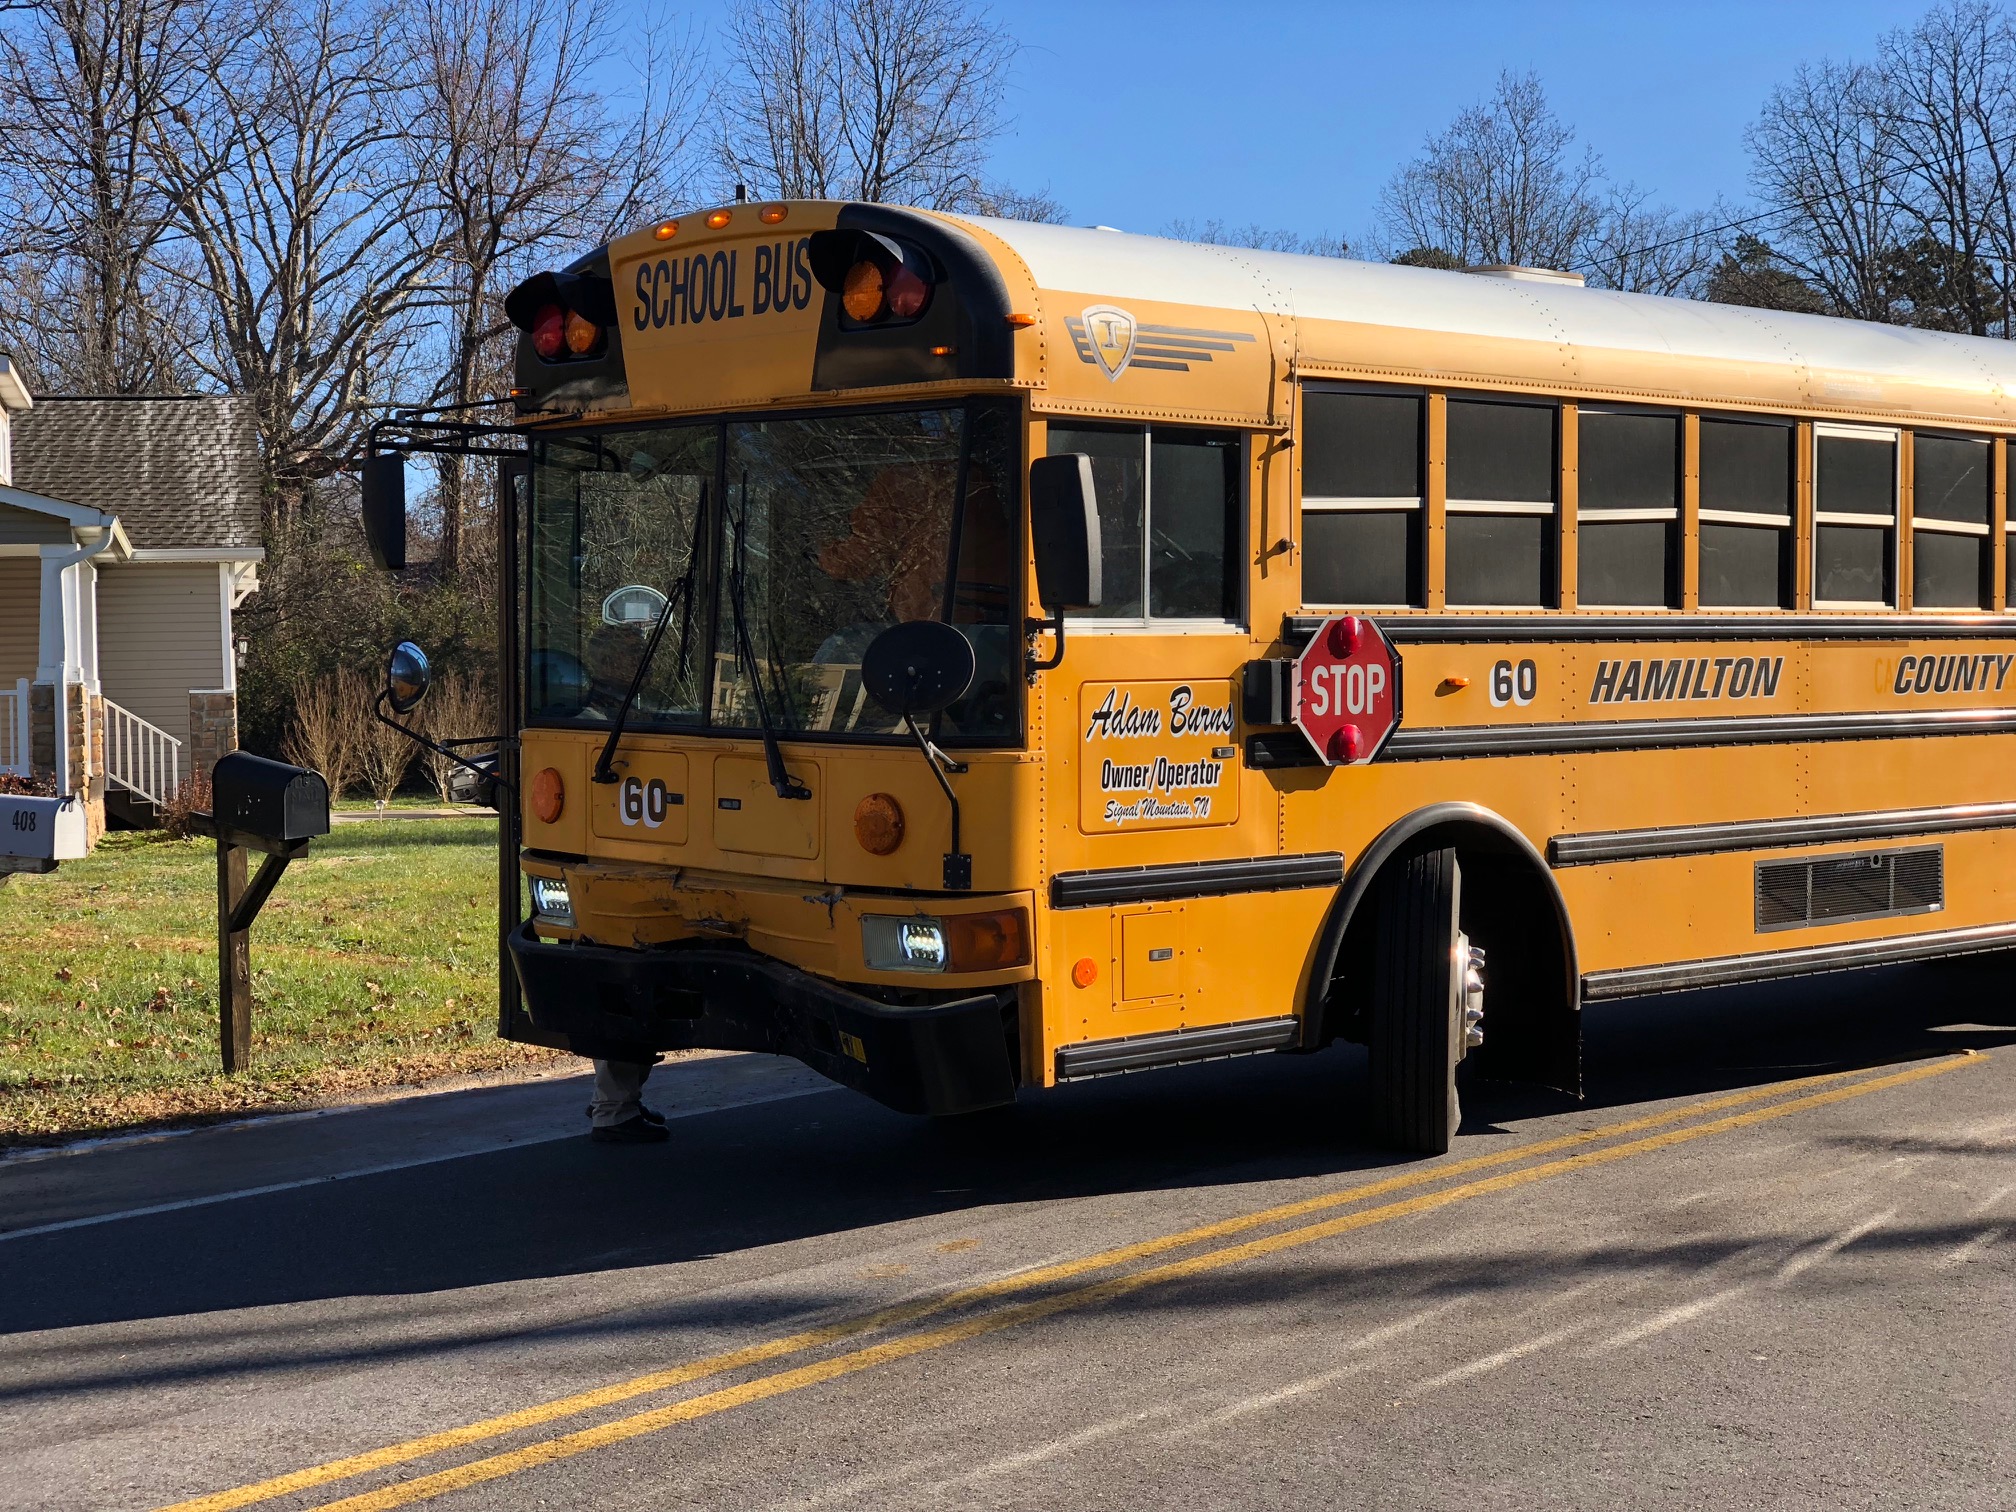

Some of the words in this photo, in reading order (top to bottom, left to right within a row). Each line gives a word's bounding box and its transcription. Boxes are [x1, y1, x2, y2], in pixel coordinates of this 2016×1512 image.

[634, 250, 744, 331] SCHOOL
[752, 237, 812, 315] BUS
[1311, 663, 1386, 716] STOP
[1488, 658, 1537, 708] 60
[1588, 656, 1785, 704] HAMILTON
[1893, 653, 2016, 695] COUNTY
[1085, 686, 1162, 743] Adam
[1169, 684, 1234, 738] Burns
[1101, 756, 1222, 796] Owner/Operator
[12, 809, 37, 832] 408
[620, 776, 668, 829] 60
[1104, 799, 1140, 826] Signal
[1193, 796, 1211, 819] TN
